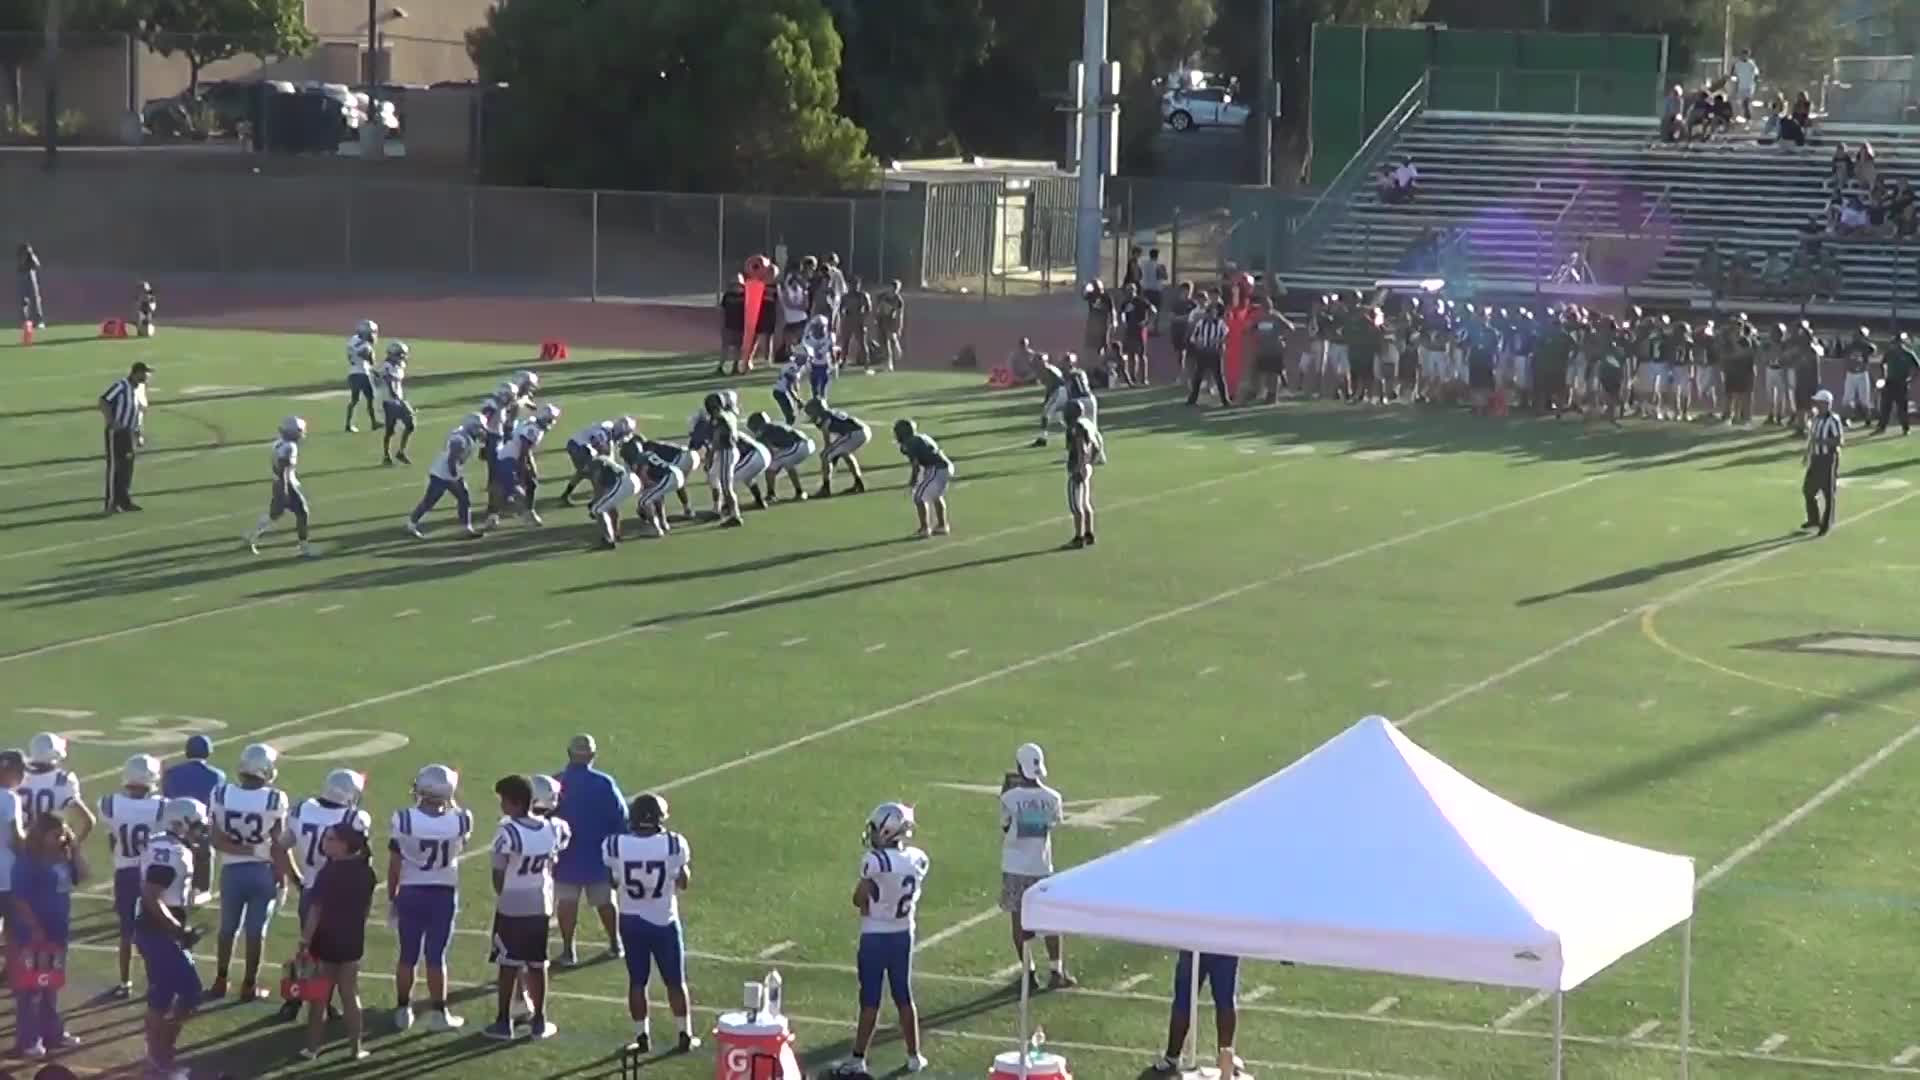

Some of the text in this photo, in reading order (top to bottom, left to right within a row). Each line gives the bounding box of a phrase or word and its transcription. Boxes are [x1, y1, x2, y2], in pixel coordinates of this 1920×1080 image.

[224, 810, 264, 845] 53
[419, 839, 450, 871] 71
[623, 860, 667, 900] 57
[894, 875, 916, 919] 2
[727, 1048, 748, 1072] G
